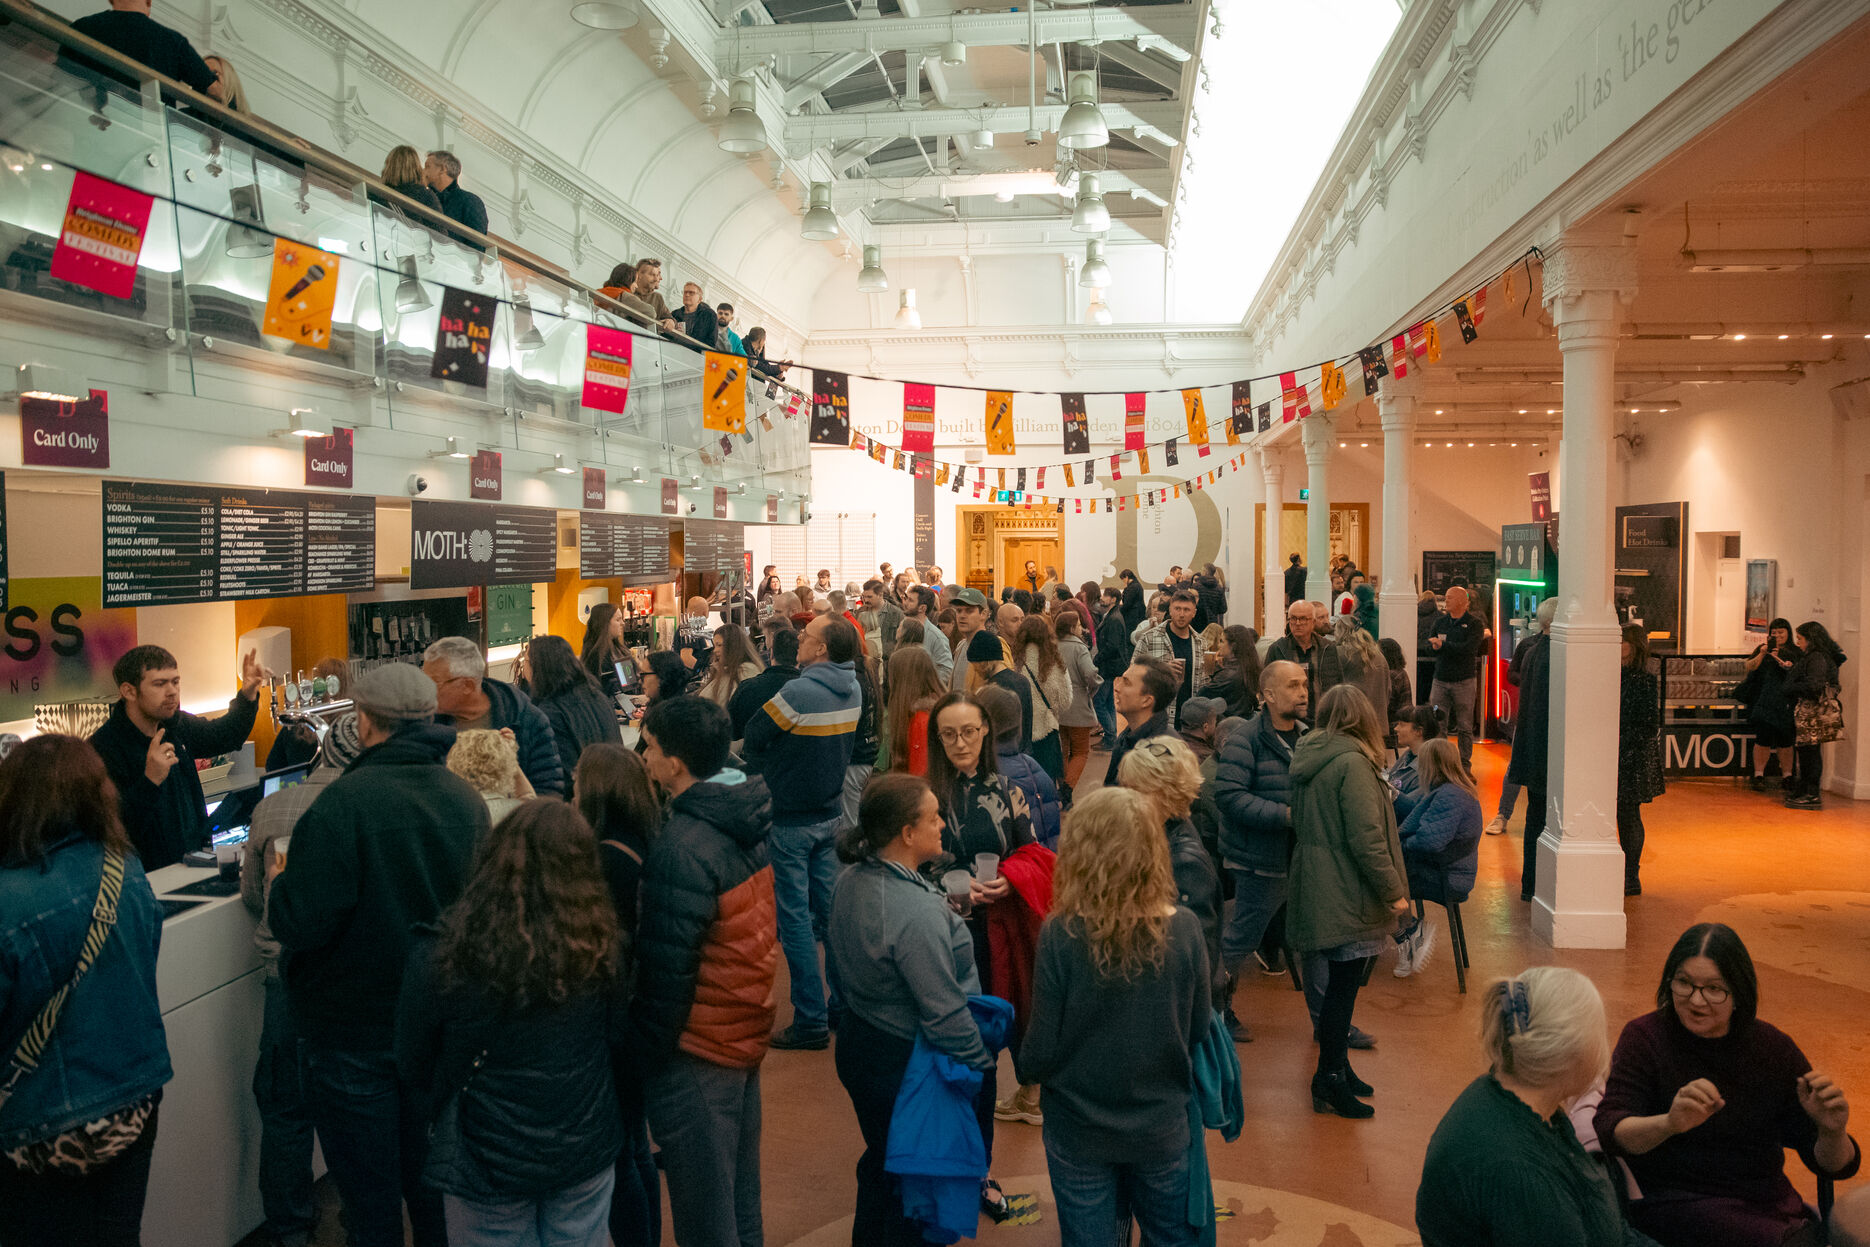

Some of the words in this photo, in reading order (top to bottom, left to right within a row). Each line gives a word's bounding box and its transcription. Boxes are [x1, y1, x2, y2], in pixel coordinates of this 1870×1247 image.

[1534, 129, 1549, 166] as
[1552, 71, 1588, 146] well
[1593, 66, 1612, 111] as
[65, 215, 140, 252] COMEDY
[64, 231, 138, 267] FESTIVAL
[441, 315, 464, 332] ha
[467, 322, 490, 338] ha
[446, 332, 470, 348] ha
[586, 370, 628, 389] FESTIVAL
[814, 392, 829, 404] ha
[832, 394, 848, 406] ha
[818, 404, 835, 418] ha
[1063, 412, 1074, 422] ha
[1076, 412, 1086, 422] ha
[940, 419, 974, 433] built
[1011, 418, 1059, 432] illiam
[1067, 422, 1078, 432] ha
[34, 429, 66, 446] Card
[68, 432, 99, 454] Only
[311, 458, 329, 472] Card
[330, 461, 348, 476] Only
[474, 478, 486, 488] Card
[487, 479, 498, 491] Only
[107, 488, 134, 502] Spirits
[107, 504, 131, 512] VODKA
[1629, 528, 1647, 537] Food
[107, 593, 152, 602] JAGERMEISTER
[496, 594, 515, 610] GIN
